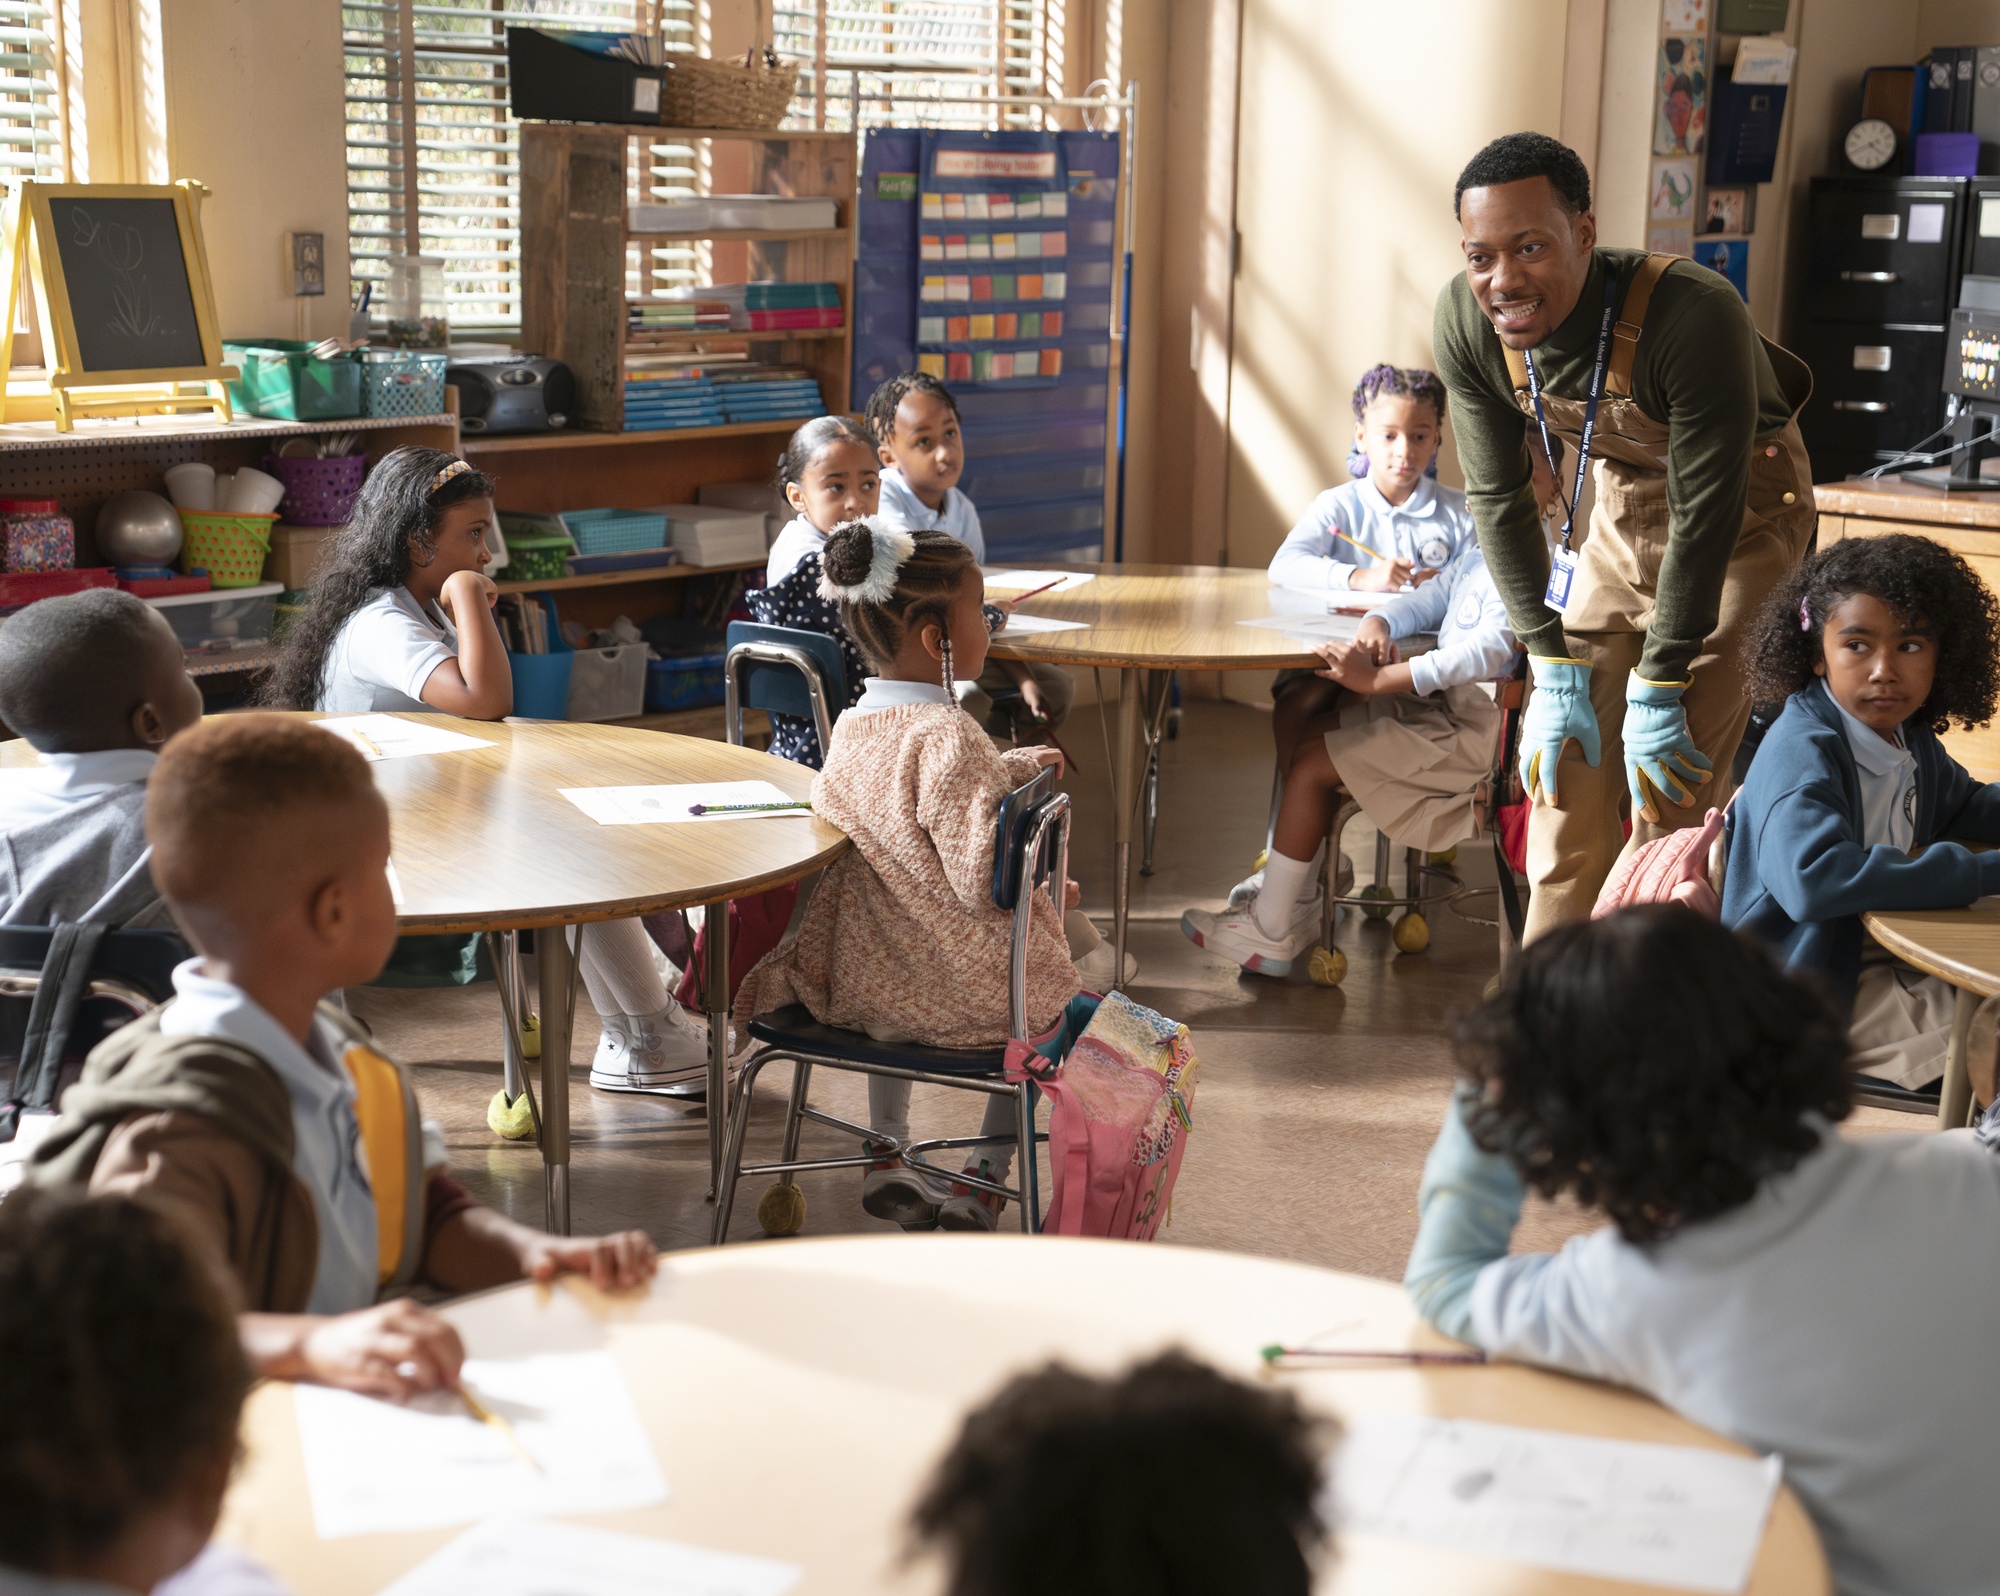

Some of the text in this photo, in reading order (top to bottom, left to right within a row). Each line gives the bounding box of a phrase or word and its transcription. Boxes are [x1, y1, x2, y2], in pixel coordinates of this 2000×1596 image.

[1602, 307, 1611, 331] Willard
[1597, 339, 1606, 361] Abbott
[1590, 362, 1603, 398] Elementary
[1583, 421, 1593, 444] Willard
[1579, 452, 1587, 474] Abbott
[1573, 474, 1584, 508] Elementary
